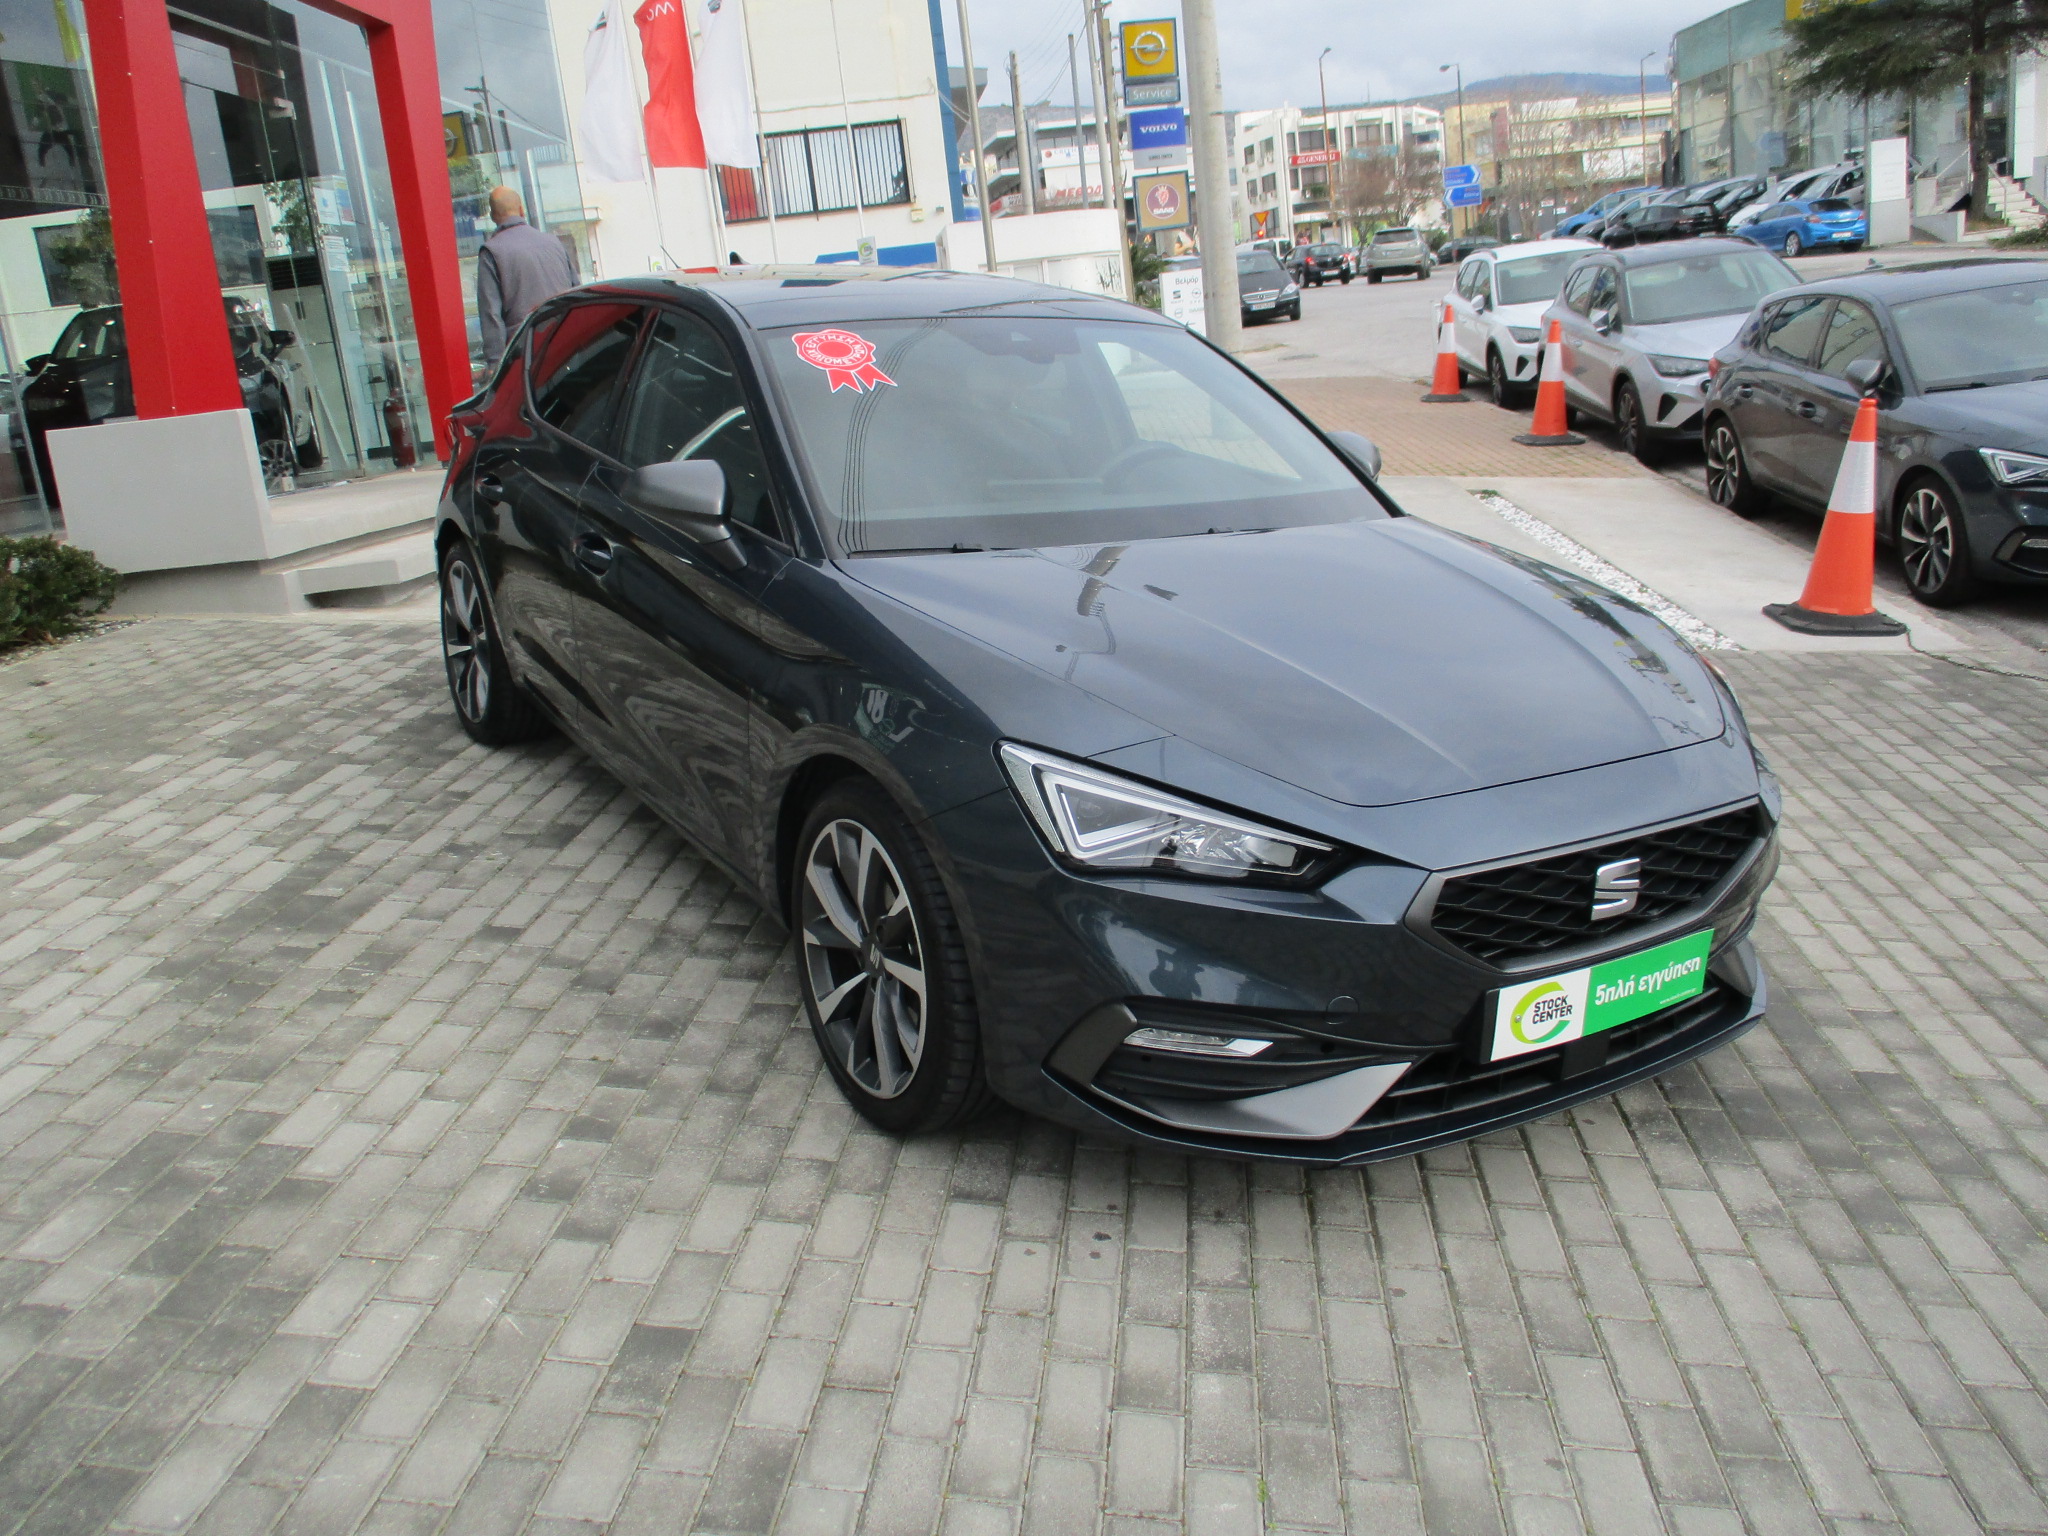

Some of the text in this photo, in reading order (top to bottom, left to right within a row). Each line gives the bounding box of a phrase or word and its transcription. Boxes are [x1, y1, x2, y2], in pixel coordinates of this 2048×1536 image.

[1133, 87, 1172, 100] Service
[1139, 123, 1178, 134] VOLVO
[1153, 206, 1175, 215] SAAB
[1175, 276, 1199, 286] Βελμάρ
[806, 334, 855, 349] ΕΓΓΥΗΣΗ
[1639, 954, 1702, 995] εγγύηση
[1534, 995, 1568, 1014] STOCK
[1532, 1004, 1573, 1025] CENTER
